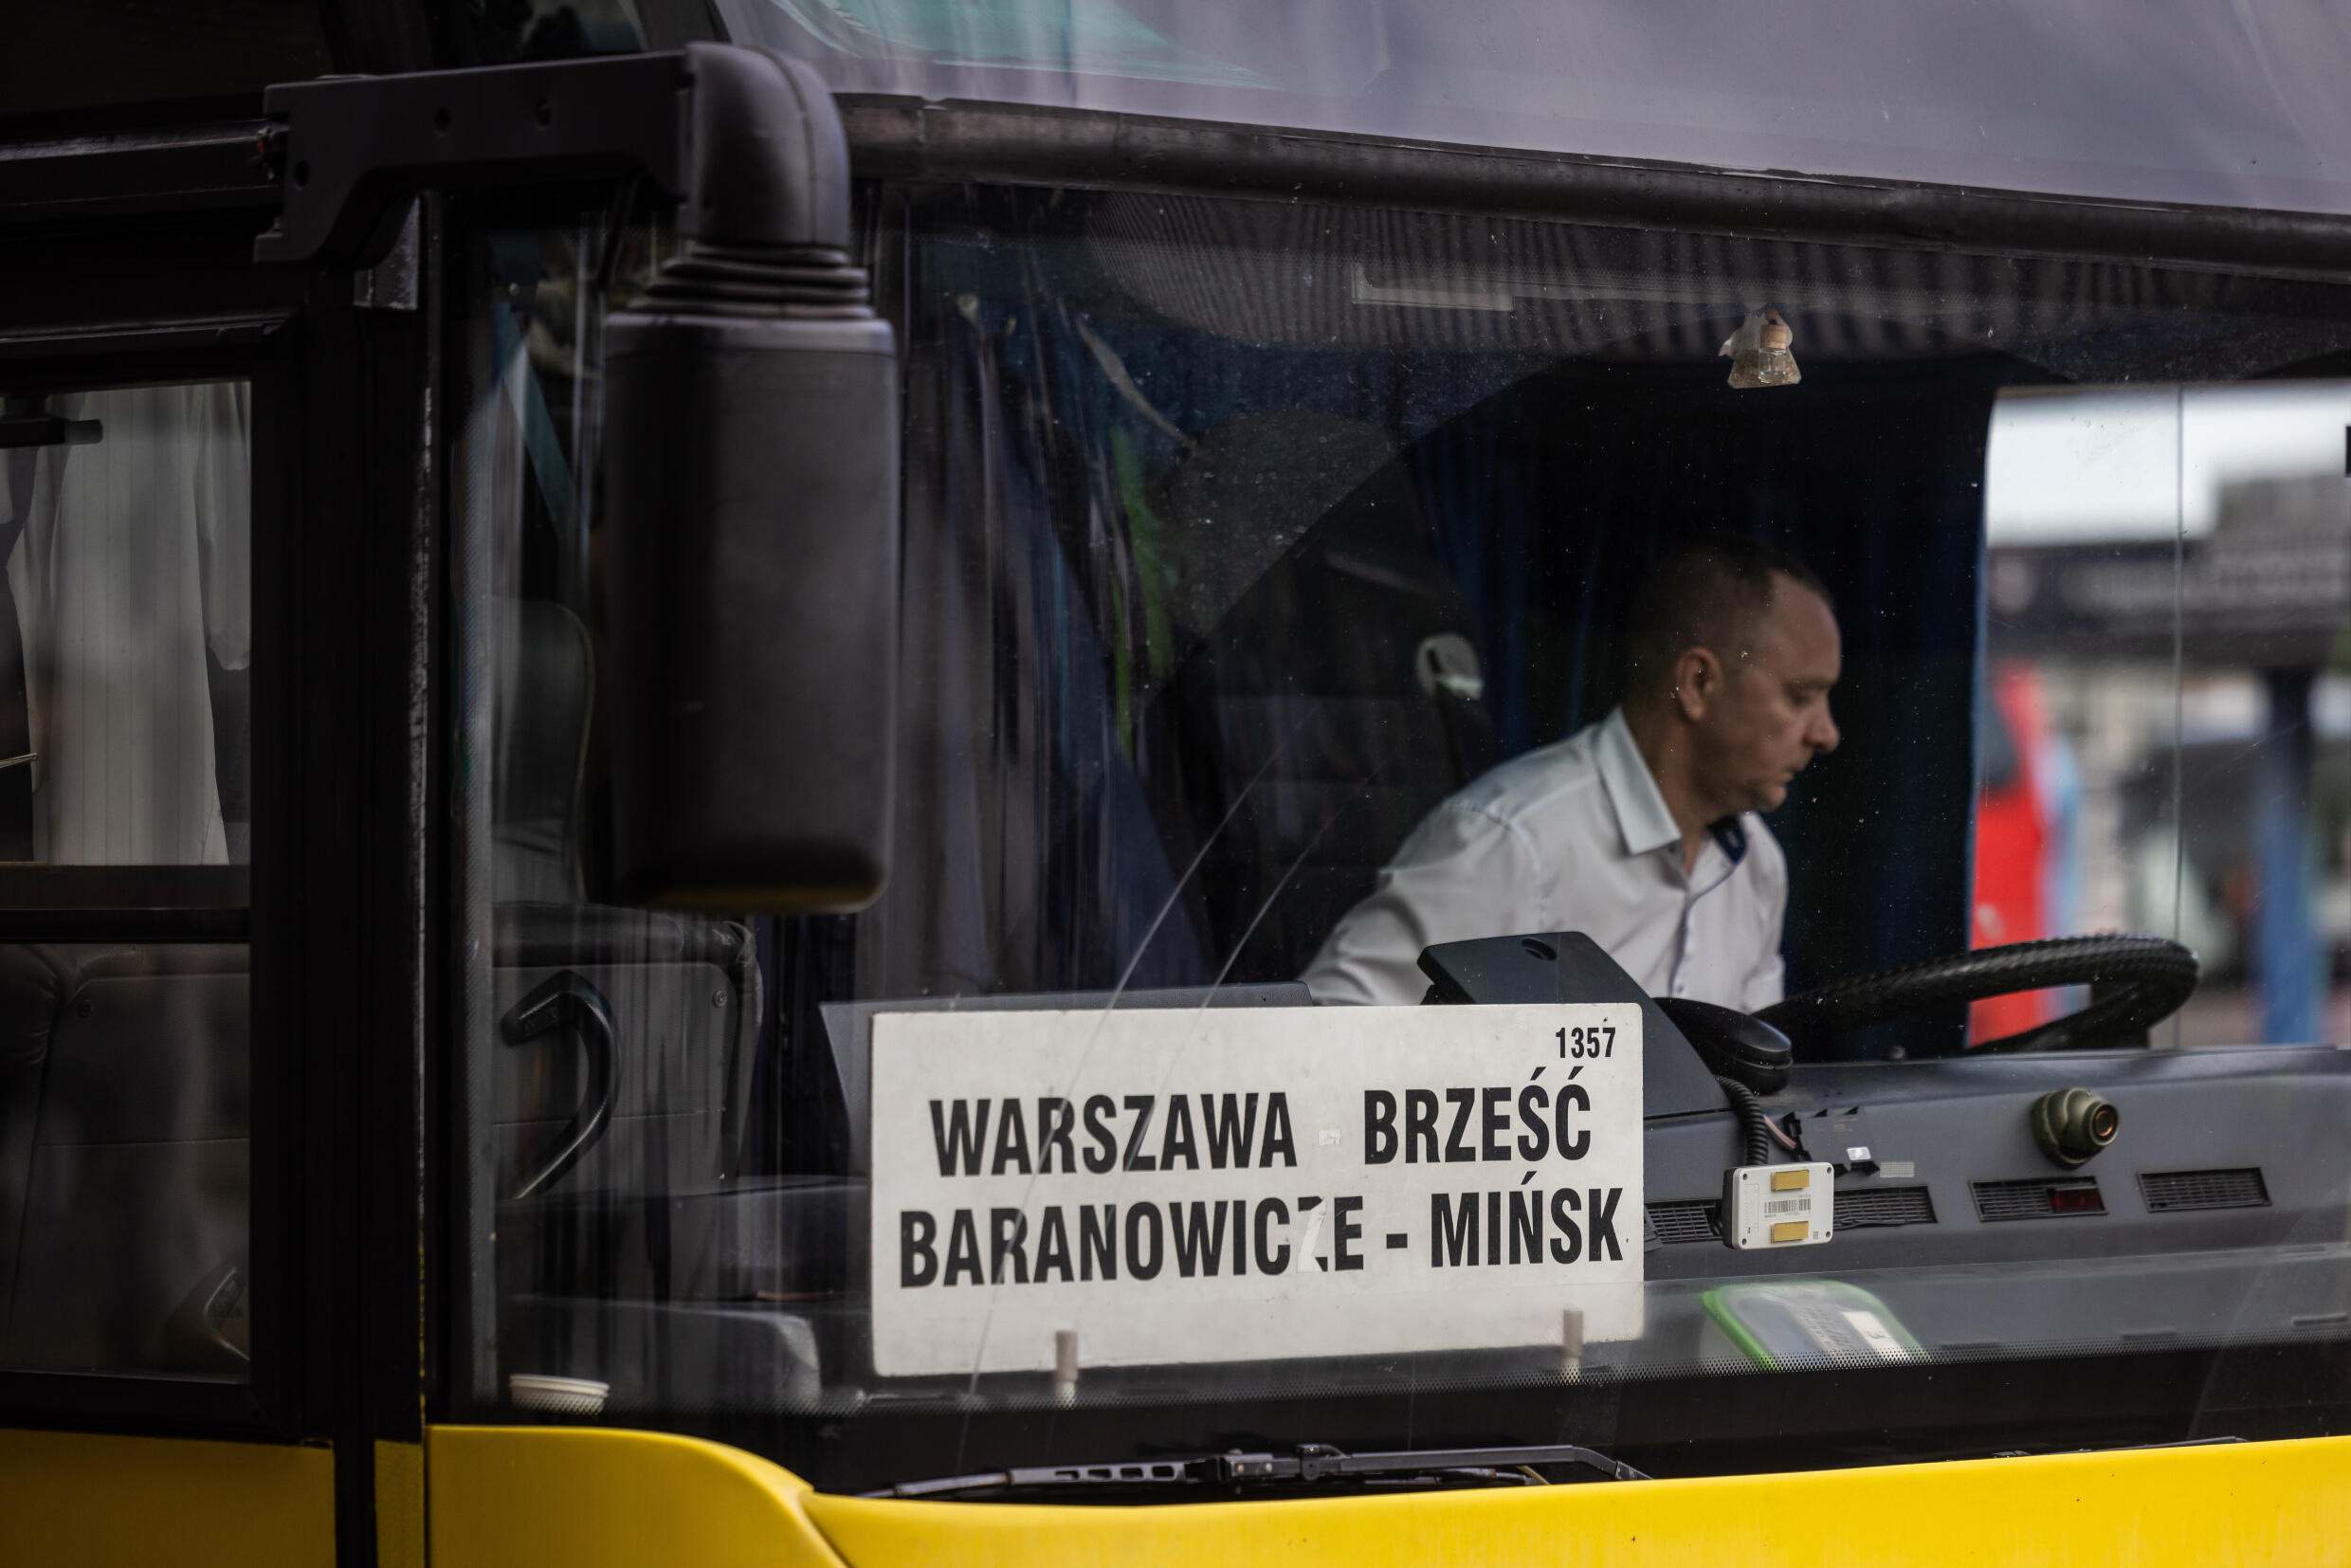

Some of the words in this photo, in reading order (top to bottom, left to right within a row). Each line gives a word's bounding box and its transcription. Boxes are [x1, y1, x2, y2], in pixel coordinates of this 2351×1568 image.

[1555, 1027, 1616, 1059] 1357
[929, 1092, 1298, 1176] WARSZAWA
[1364, 1066, 1592, 1165] BRZEŚĆ
[1431, 1171, 1624, 1267] MIŃSK
